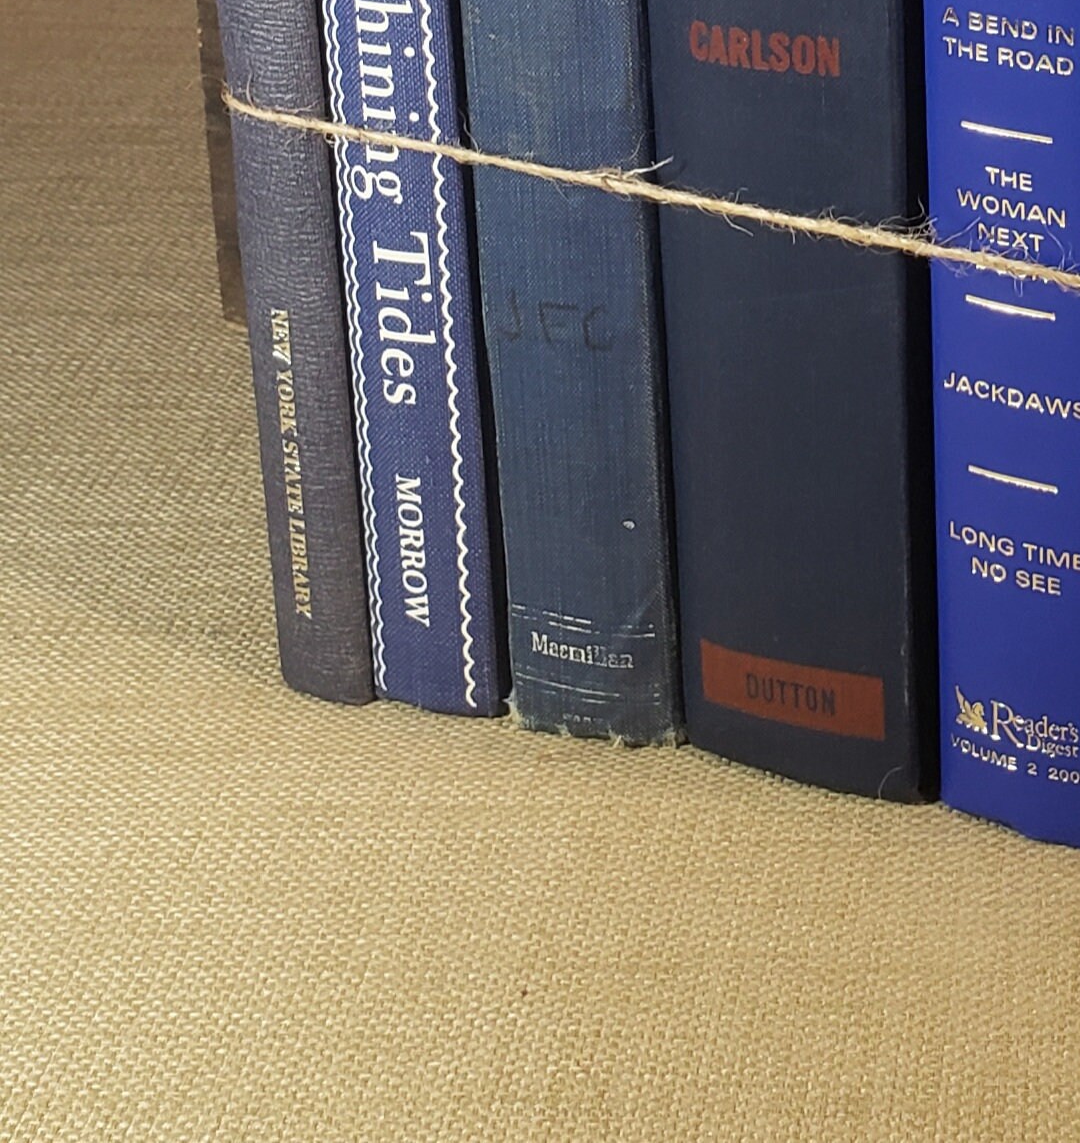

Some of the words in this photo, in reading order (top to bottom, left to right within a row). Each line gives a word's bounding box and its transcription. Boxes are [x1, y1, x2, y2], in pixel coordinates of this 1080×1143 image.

[942, 7, 960, 27] A
[968, 11, 1039, 40] BEND
[1047, 24, 1075, 47] IN
[689, 20, 841, 78] CARLSON
[942, 36, 989, 63] THE
[997, 47, 1075, 77] ROAD
[984, 166, 1033, 192] THE
[957, 188, 1067, 229] WOMAN
[978, 222, 1045, 253] NEXT
[270, 307, 293, 367] NEW
[372, 231, 437, 408] Tides
[274, 369, 299, 437] YORK
[280, 438, 304, 514] STATE
[394, 474, 431, 628] MORROW
[950, 521, 1015, 557] LONG
[287, 517, 313, 620] LIBRARY
[971, 557, 1007, 582] NO
[1016, 570, 1061, 596] SEE
[530, 631, 634, 669] Macmillan
[746, 672, 836, 717] DUTTON
[990, 699, 1080, 748] Reader's
[1026, 732, 1080, 758] Digest
[950, 733, 1018, 771] VOLUME
[1027, 762, 1038, 776] 2
